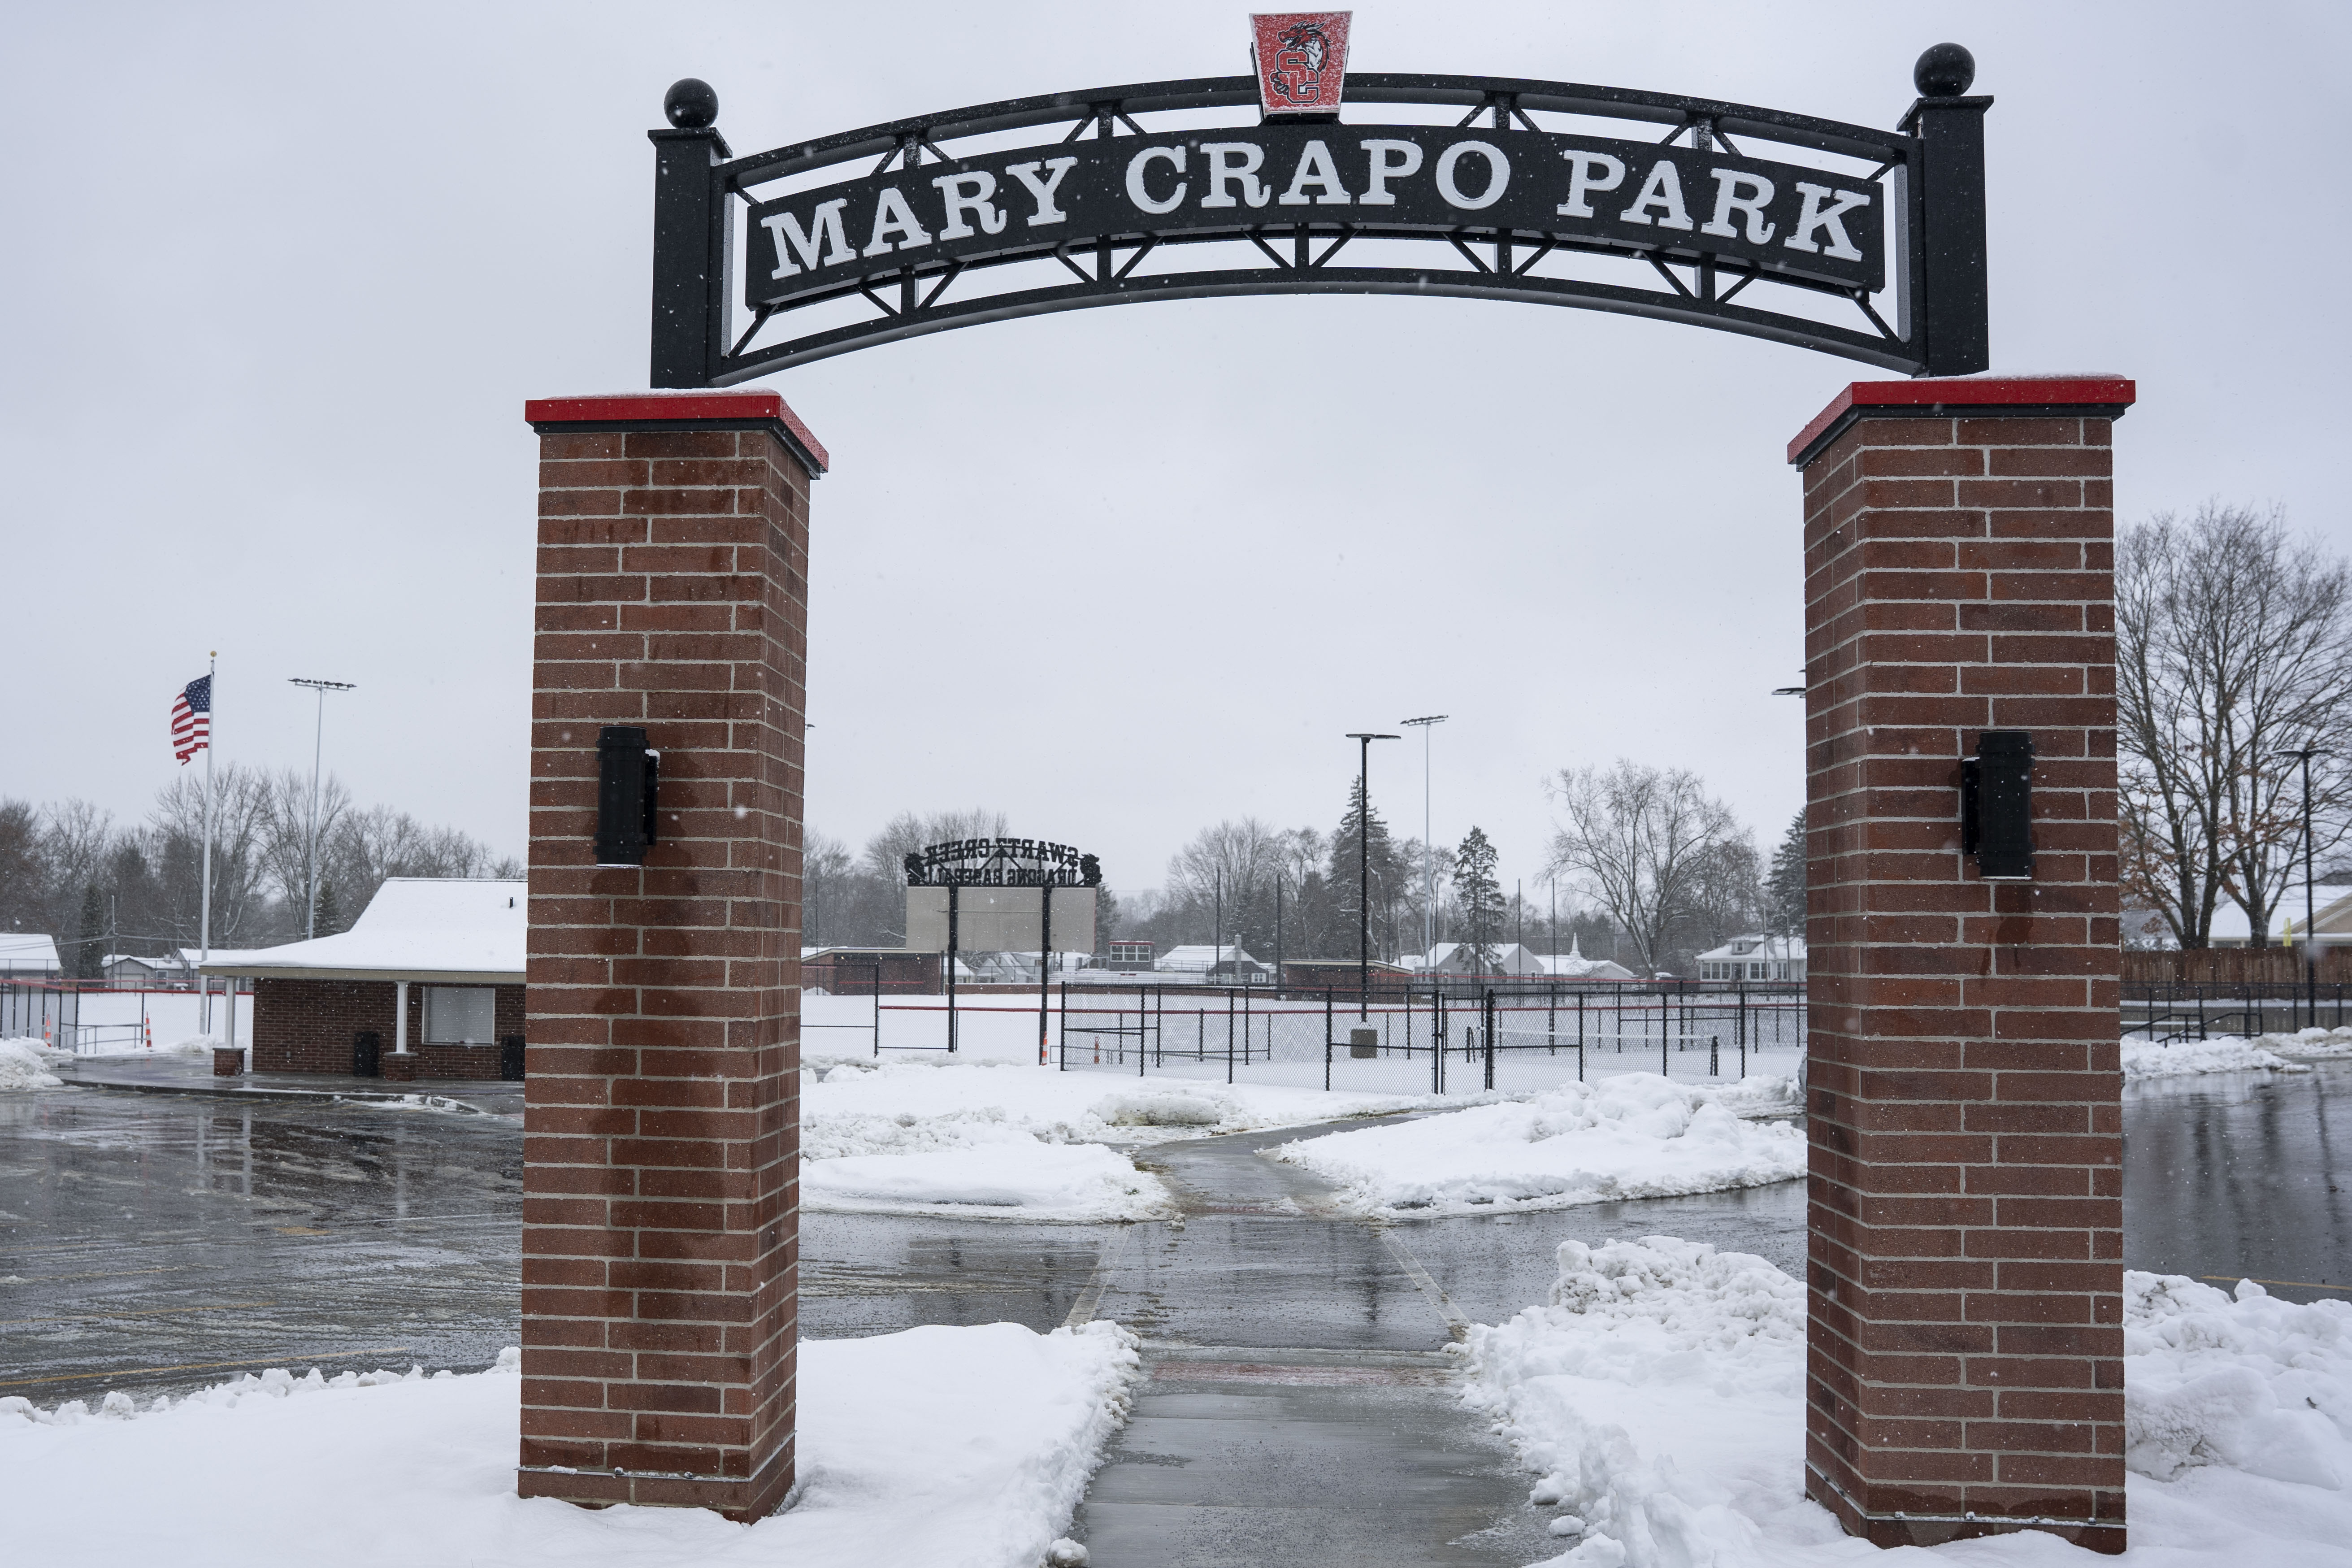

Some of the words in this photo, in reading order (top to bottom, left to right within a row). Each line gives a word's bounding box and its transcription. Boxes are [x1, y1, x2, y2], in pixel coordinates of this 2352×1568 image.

[760, 156, 1077, 280] MARY
[1126, 139, 1510, 214] CRAPO
[1557, 150, 1870, 262] PARK
